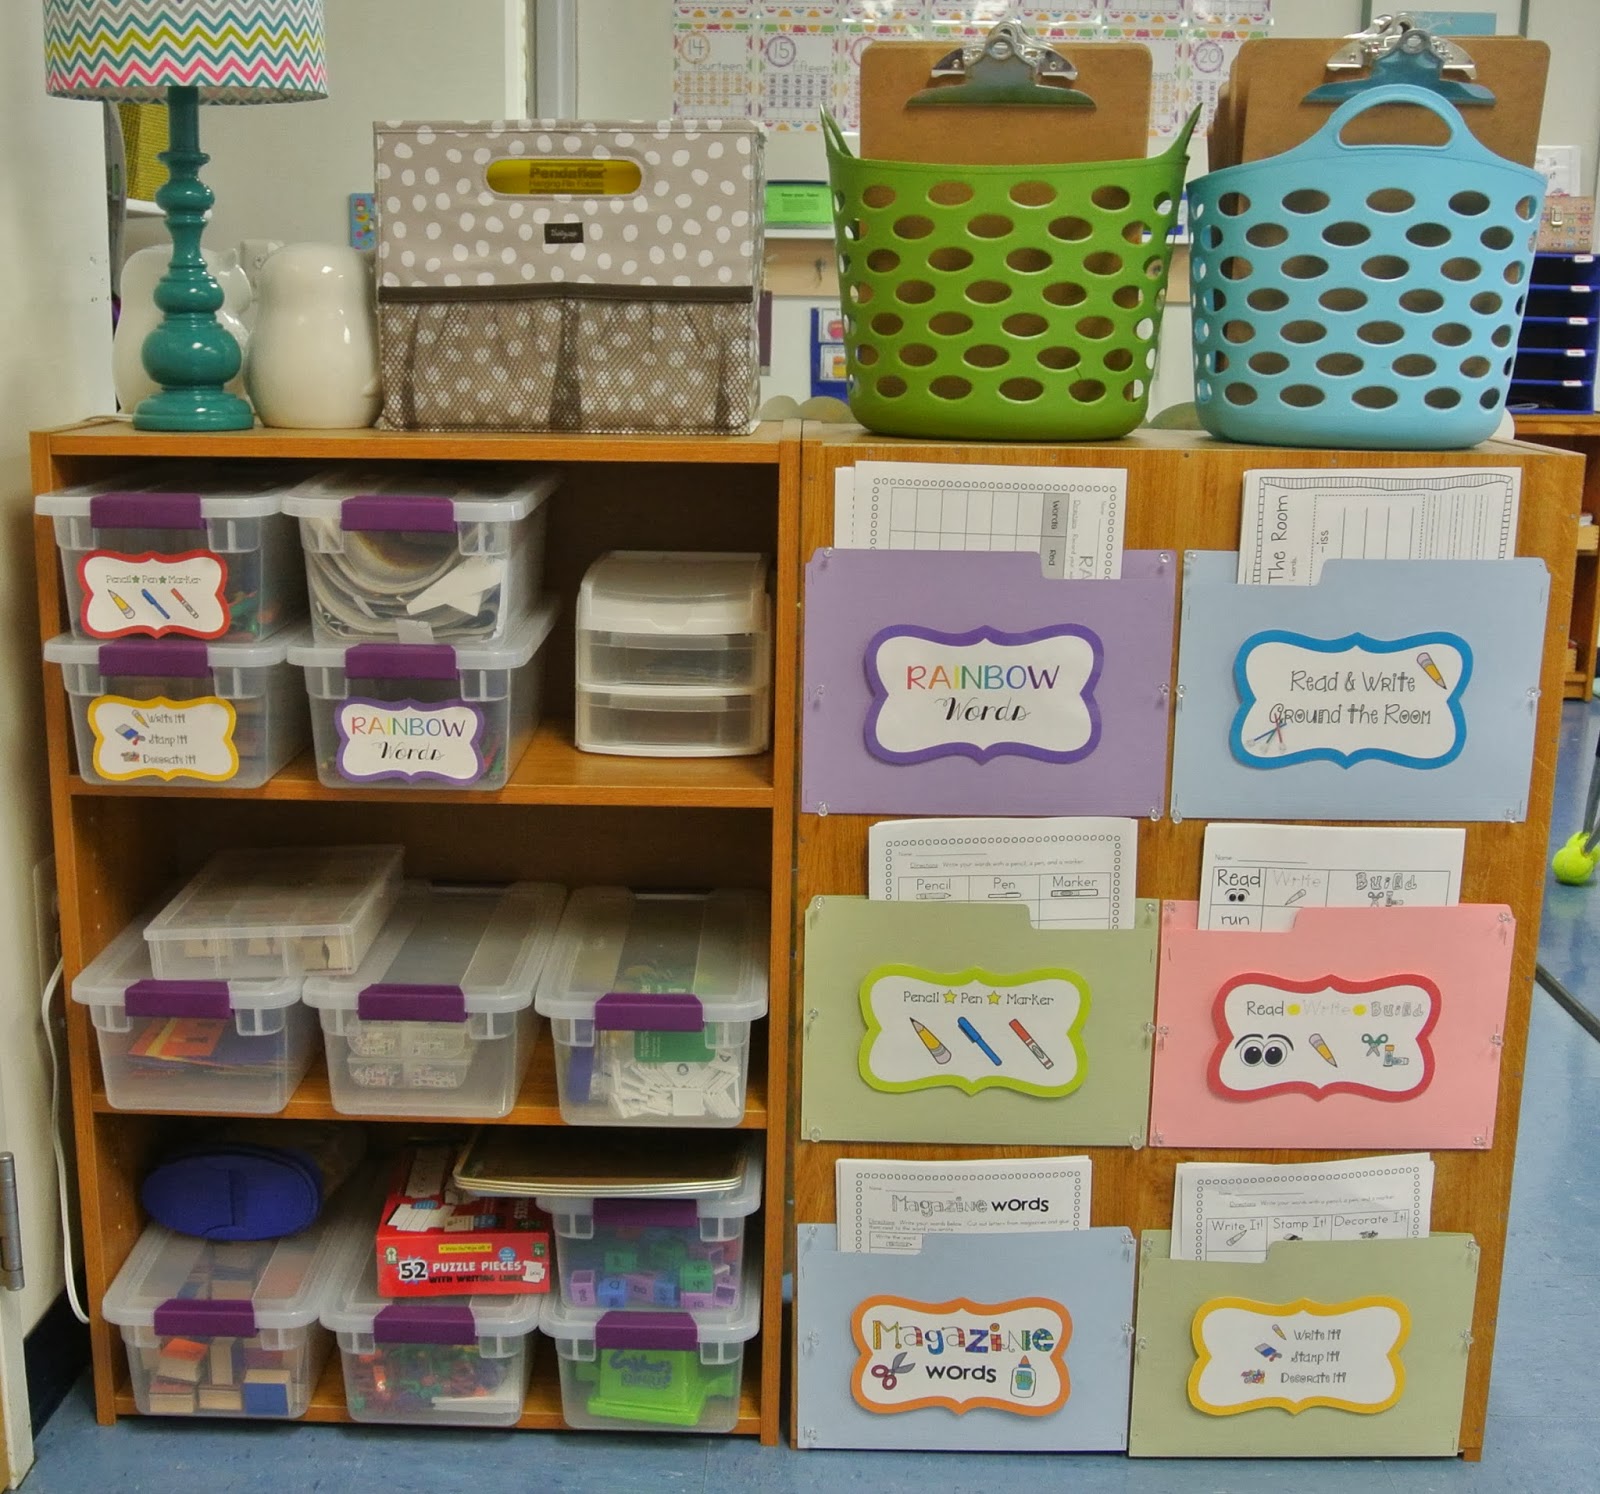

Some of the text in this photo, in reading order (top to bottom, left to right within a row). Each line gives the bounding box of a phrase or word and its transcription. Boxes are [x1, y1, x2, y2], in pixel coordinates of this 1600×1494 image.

[688, 39, 705, 56] 14
[774, 41, 790, 59] 15
[1199, 48, 1220, 64] 20
[692, 60, 744, 72] fourteen
[793, 60, 829, 74] fifteen
[1267, 494, 1289, 584] The Room
[105, 574, 201, 584] Pencil Pen Marker
[907, 664, 1060, 690] RAINBOW
[1290, 670, 1339, 692] Read
[1344, 671, 1356, 692] &
[935, 697, 1031, 721] Words
[1347, 703, 1379, 725] the
[352, 716, 466, 738] RAINBOW
[372, 741, 446, 761] Words
[916, 875, 1098, 891] Pencil Pen Marker
[1217, 868, 1261, 888] Read
[1221, 915, 1250, 925] run
[903, 990, 1055, 1006] Pencil Pen Marker
[1246, 1000, 1285, 1017] Read
[891, 1194, 1050, 1218] Magazine words
[1211, 1219, 1246, 1231] Write
[1273, 1217, 1309, 1232] Stamp
[1334, 1215, 1389, 1228] Decorate
[400, 1261, 522, 1280] 52 PUZZLE PIECES
[872, 1319, 1055, 1356] Magazine
[1291, 1350, 1325, 1365] Stamp
[925, 1365, 997, 1383] words
